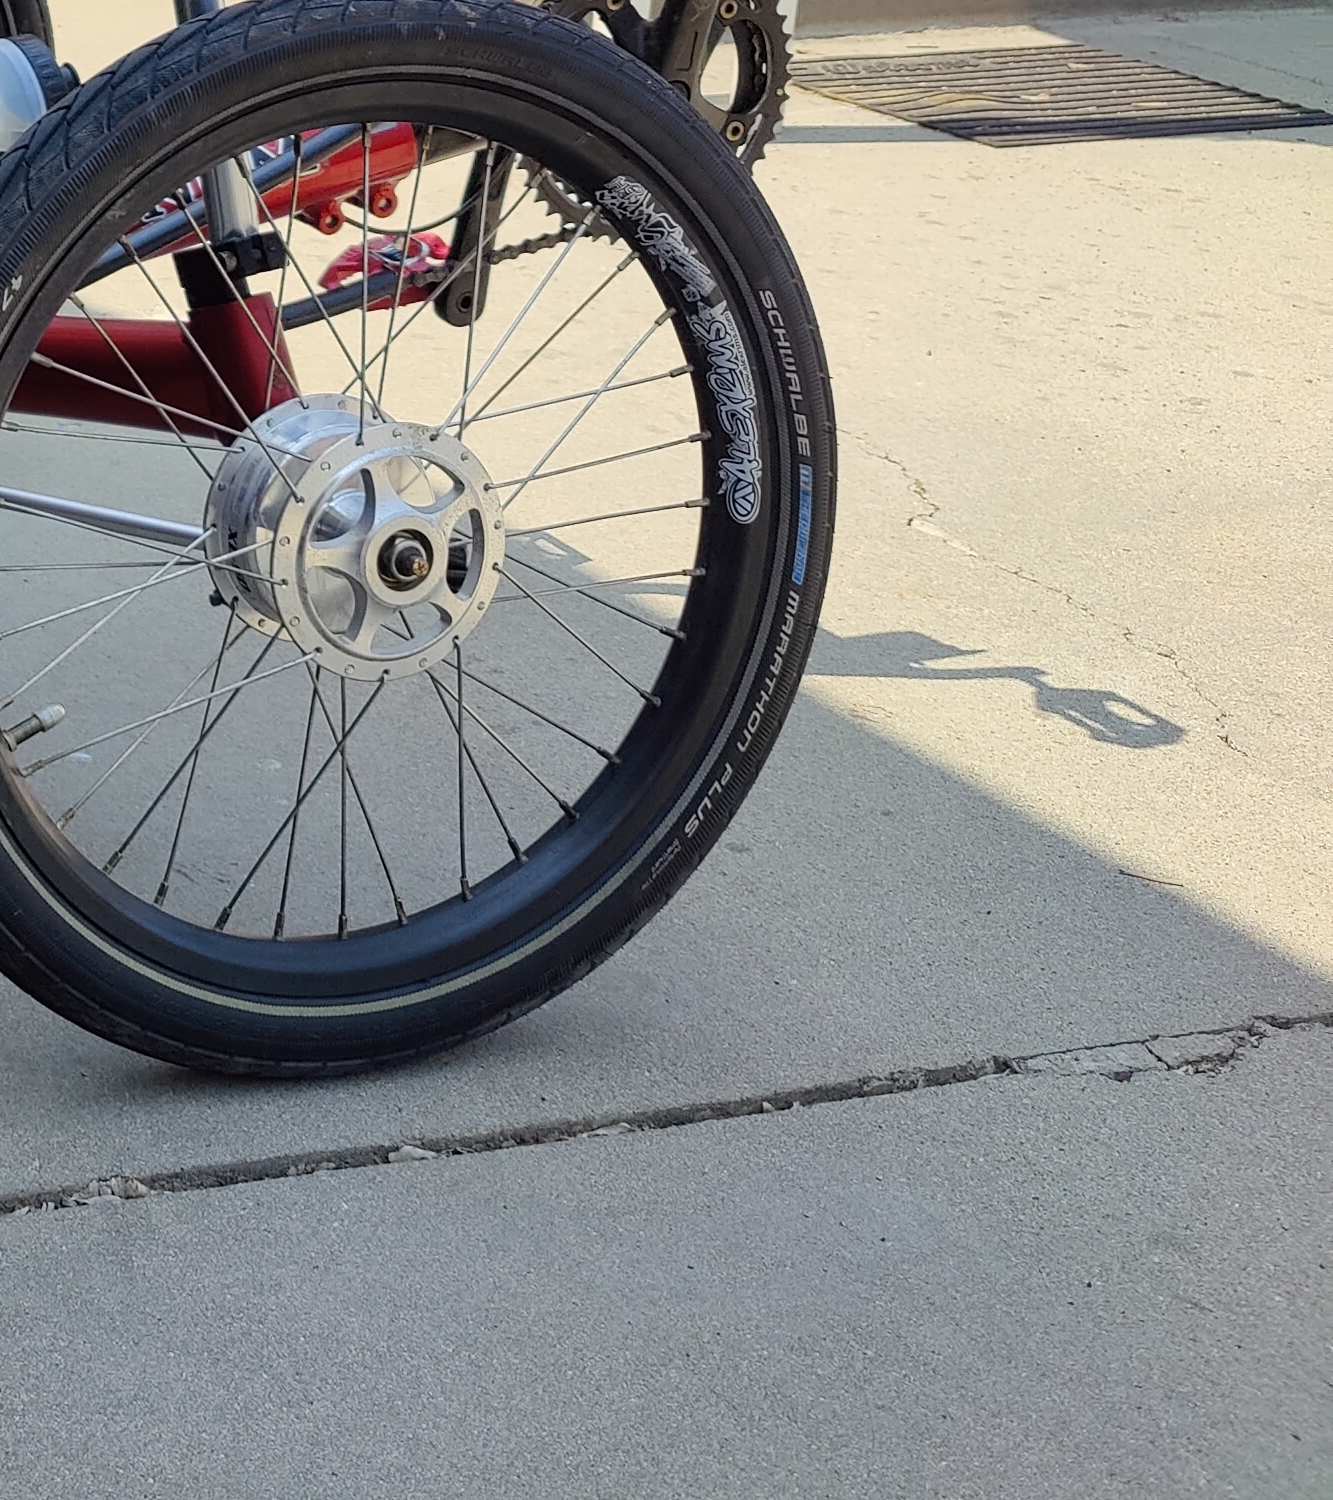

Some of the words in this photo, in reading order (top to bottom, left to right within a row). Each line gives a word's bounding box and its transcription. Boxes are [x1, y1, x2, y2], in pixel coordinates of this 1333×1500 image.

[759, 288, 813, 458] SCHWALBE
[736, 589, 800, 752] MARATHON
[684, 761, 733, 839] PLUS
